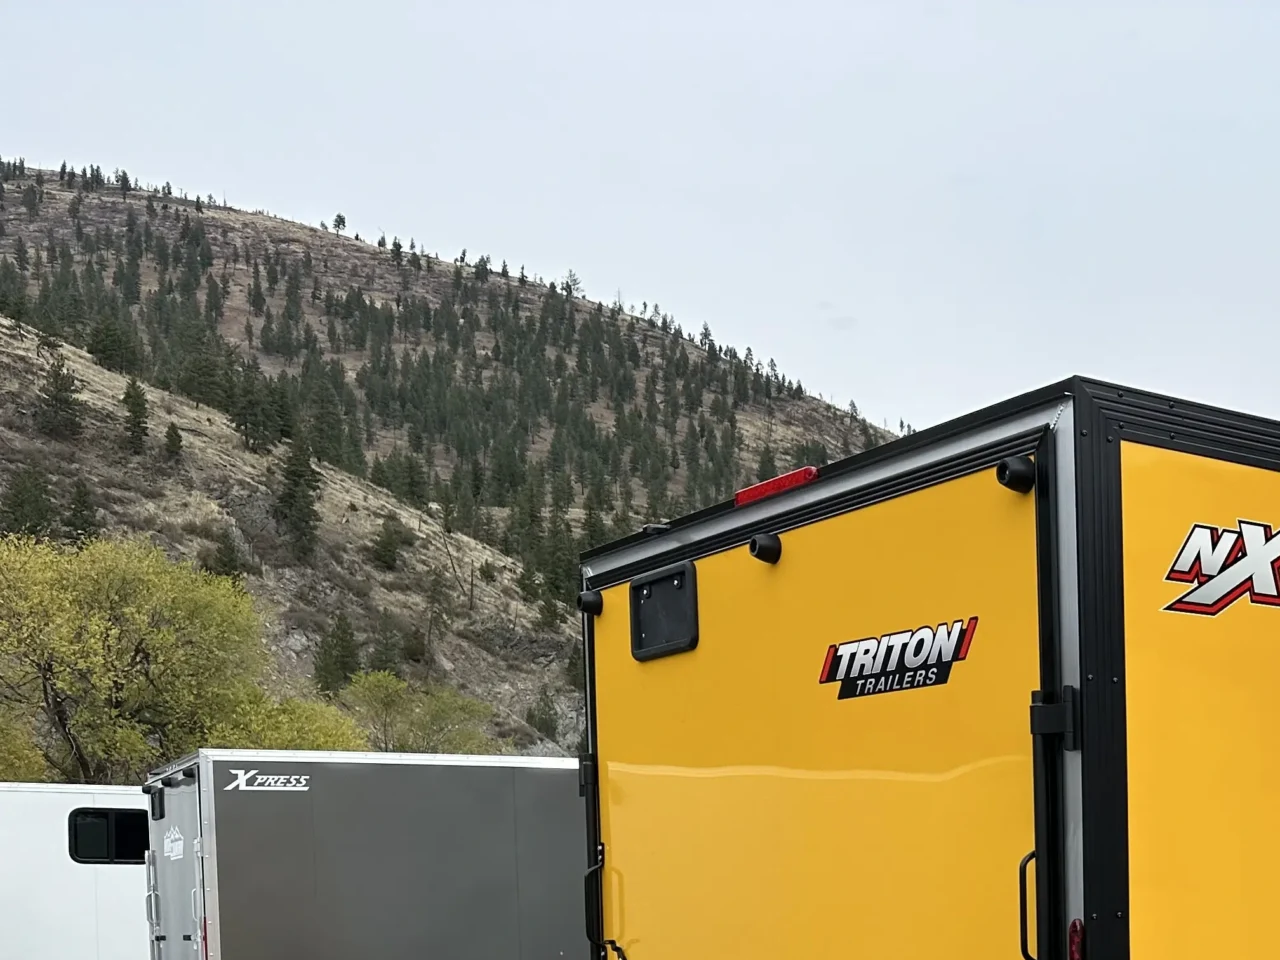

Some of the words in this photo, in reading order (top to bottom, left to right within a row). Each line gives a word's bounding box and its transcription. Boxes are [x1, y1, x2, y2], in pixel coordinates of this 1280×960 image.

[836, 619, 964, 681] TRITON
[855, 667, 938, 696] TRAILERS
[223, 769, 310, 791] XPRESS
